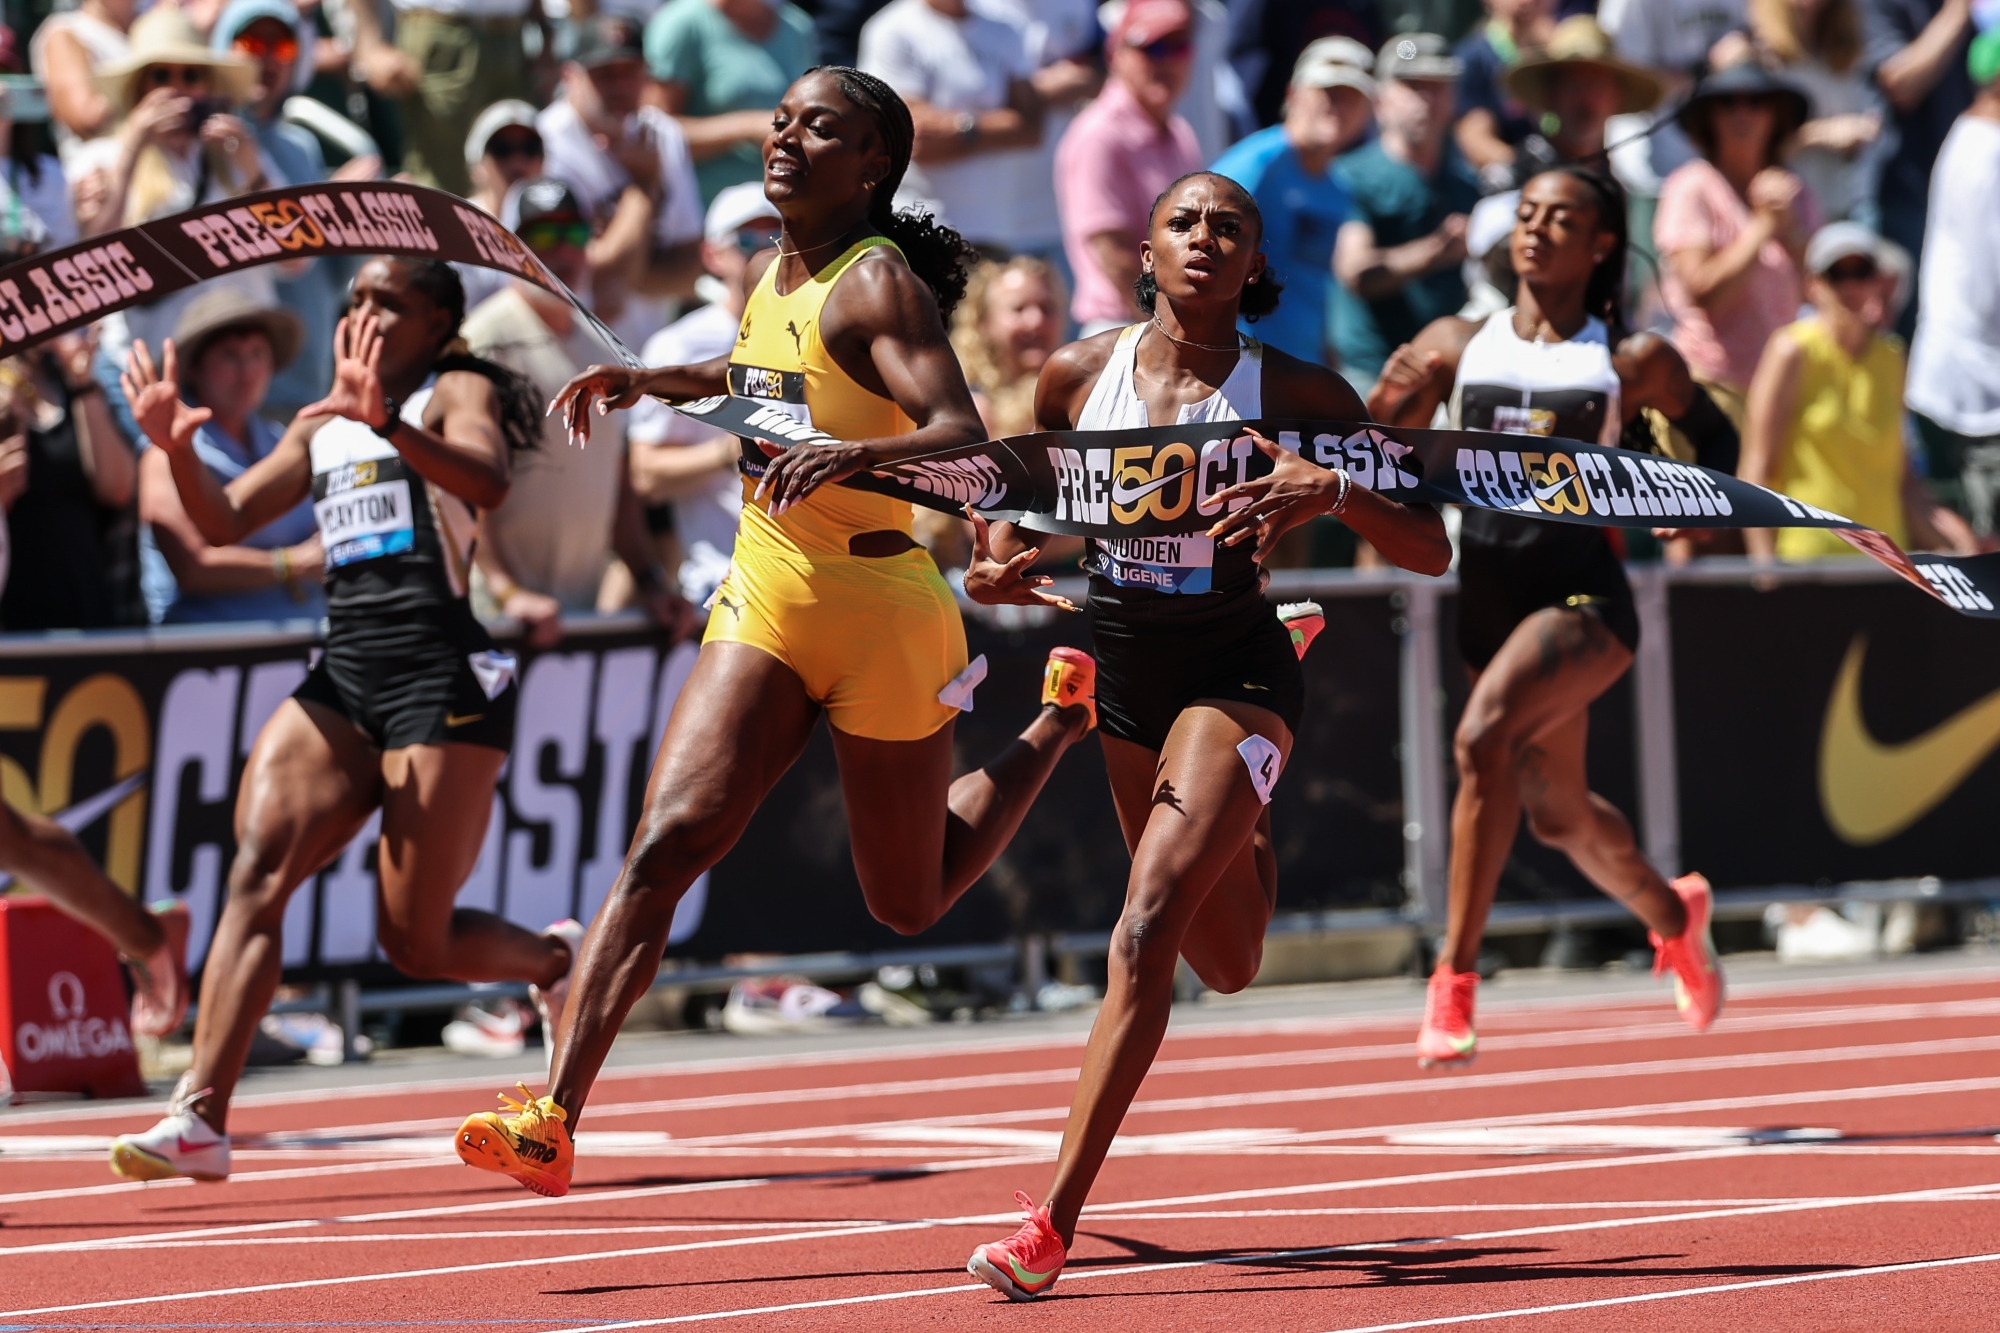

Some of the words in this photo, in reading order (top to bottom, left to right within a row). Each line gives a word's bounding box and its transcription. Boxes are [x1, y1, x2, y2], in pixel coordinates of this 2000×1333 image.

[1107, 538, 1182, 564] WOODEN
[1112, 564, 1174, 588] EUGENE
[1260, 752, 1274, 787] 4
